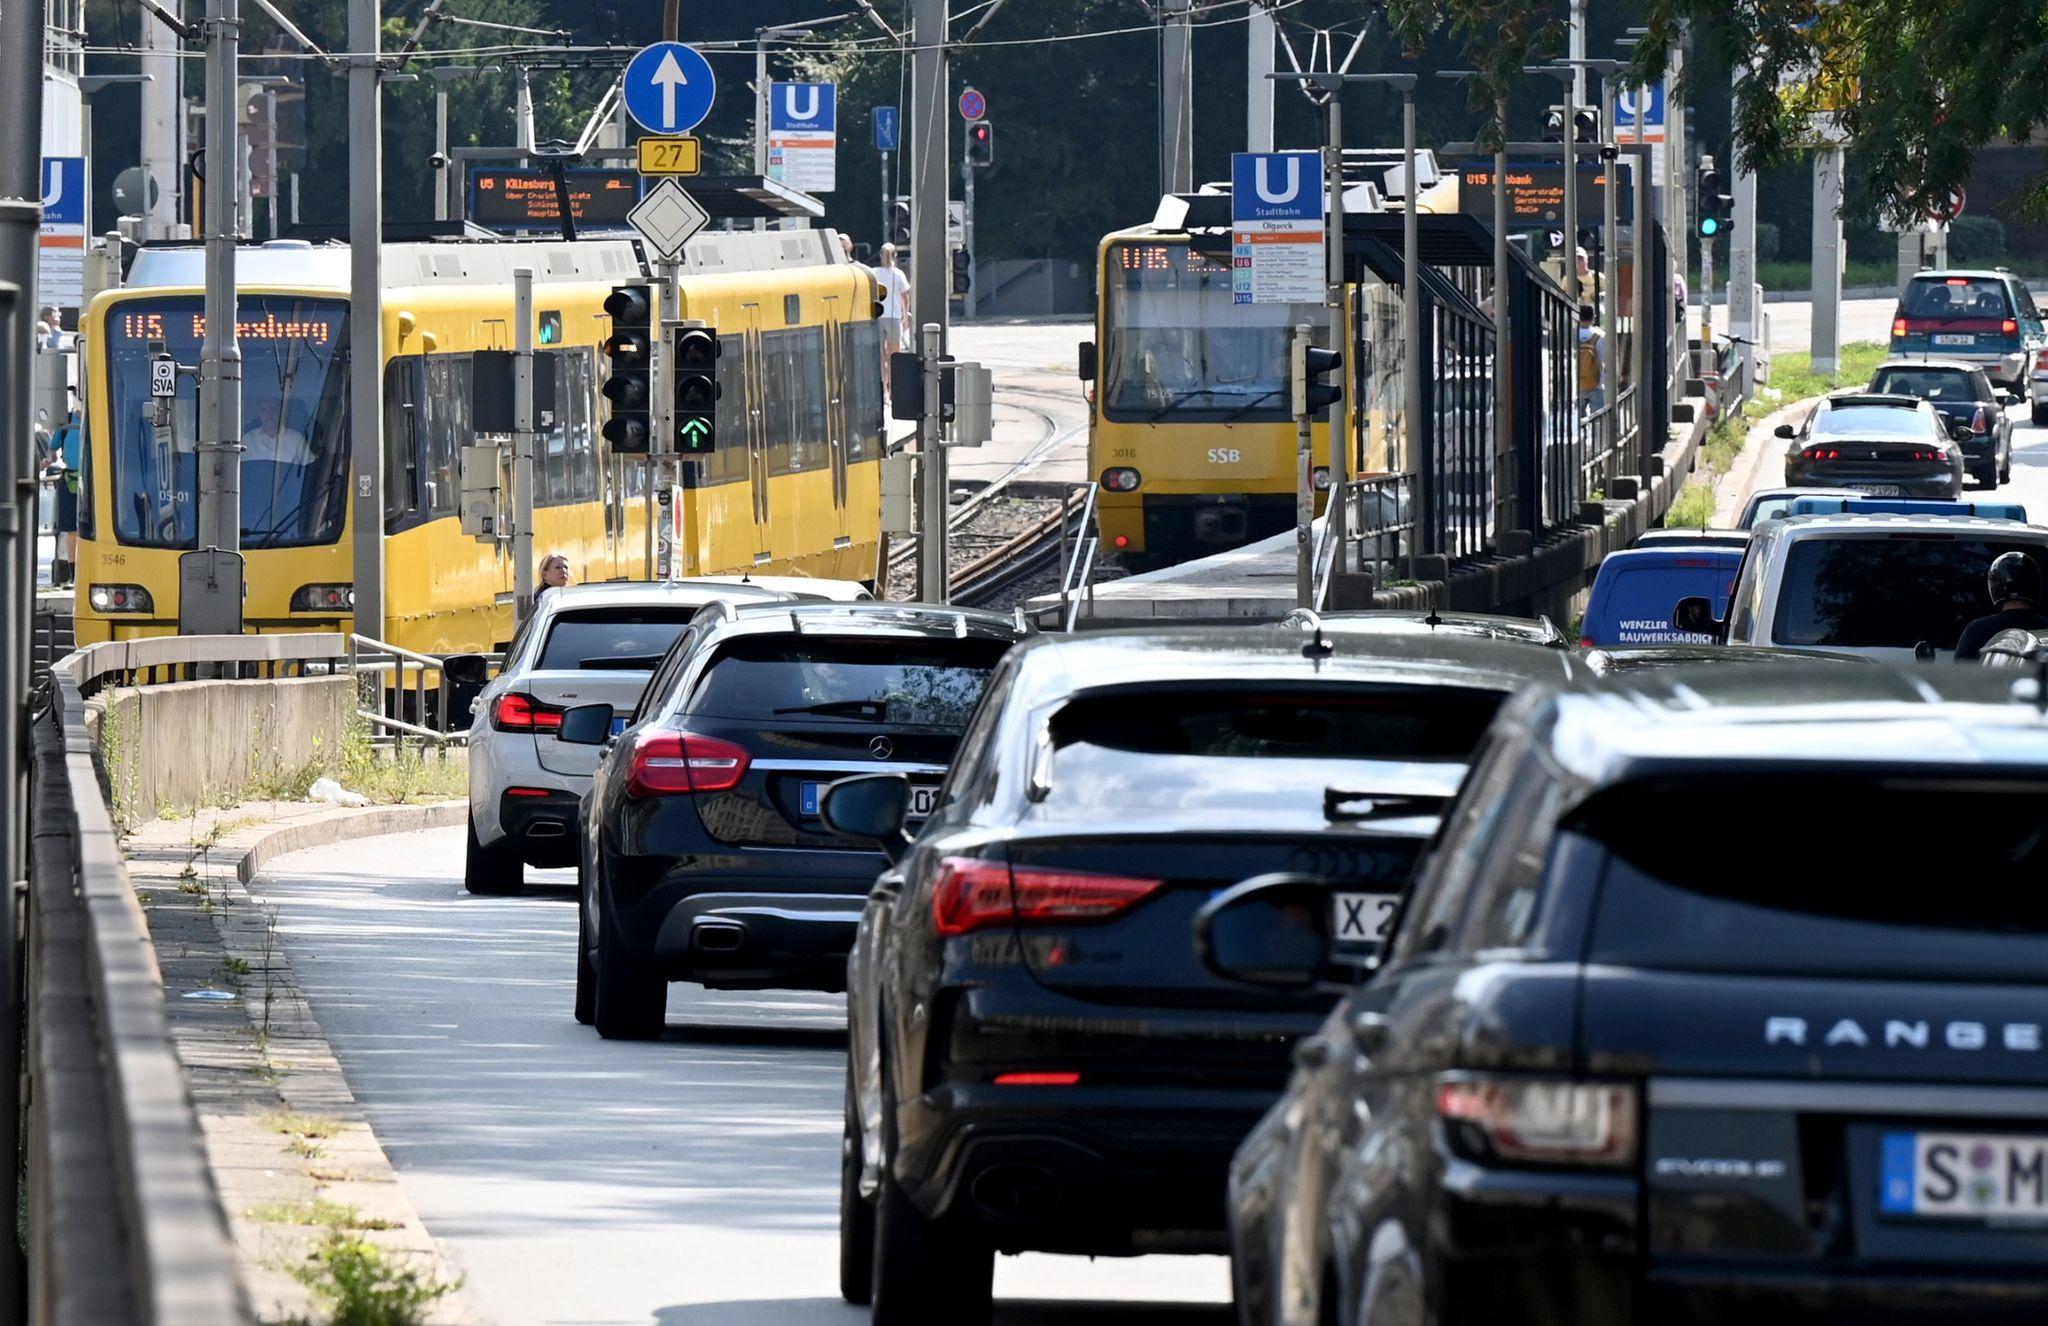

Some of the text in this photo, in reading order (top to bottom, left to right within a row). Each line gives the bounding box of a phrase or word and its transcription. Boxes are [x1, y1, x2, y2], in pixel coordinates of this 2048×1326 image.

[786, 85, 819, 120] U
[652, 144, 684, 168] 27
[480, 178, 556, 191] U5 Killesberg
[1255, 157, 1300, 204] U
[1466, 173, 1488, 185] U15
[1255, 207, 1301, 217] Stadtbahn
[1262, 221, 1294, 232] Olgaeck
[1122, 247, 1168, 269] U15
[1236, 247, 1250, 256] U5
[1236, 258, 1250, 267] U6
[1235, 294, 1251, 302] U15
[125, 313, 328, 344] U5 Kesberg
[153, 379, 174, 393] SVA
[1207, 447, 1240, 464] SSB
[159, 490, 189, 503] 05-01
[102, 554, 126, 566] 3546
[1620, 620, 1667, 630] WENZLER
[1343, 898, 1364, 935] X
[1765, 1016, 2042, 1052] RANGE
[1924, 1144, 1960, 1203] S
[2006, 1147, 2044, 1206] M
